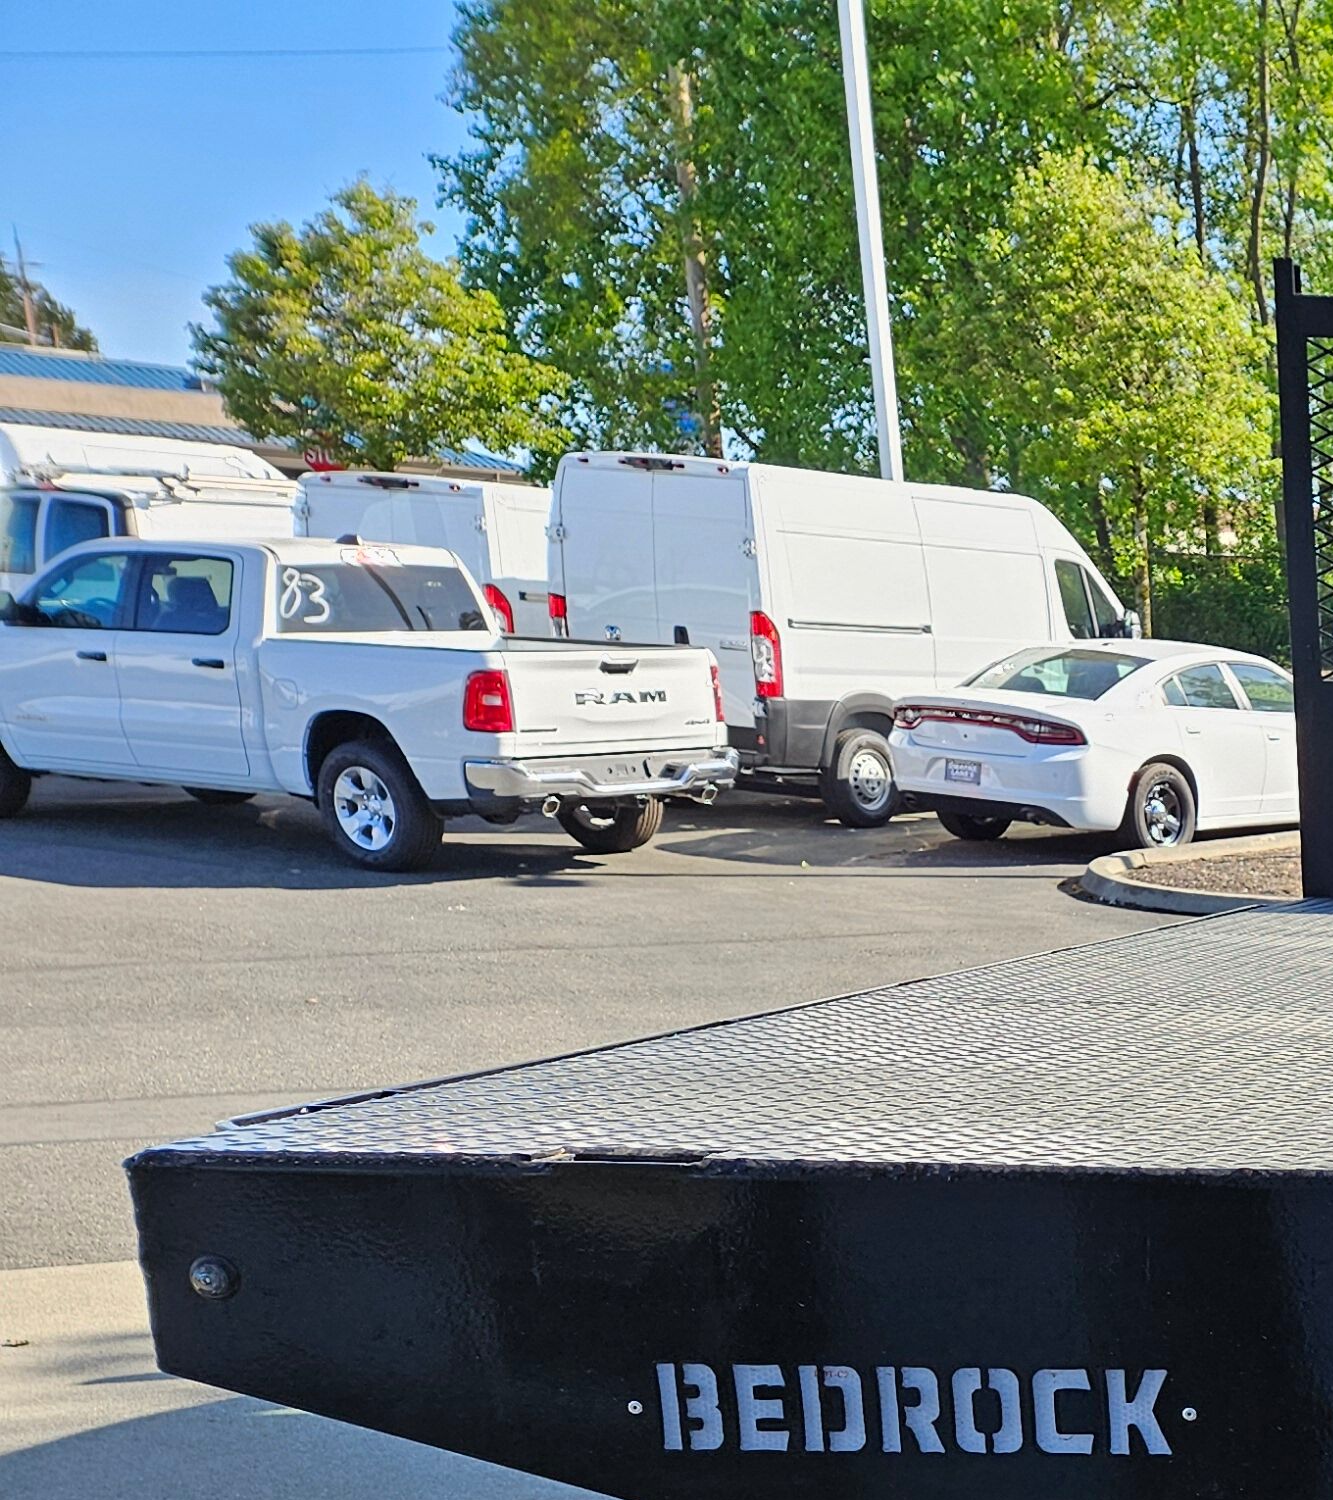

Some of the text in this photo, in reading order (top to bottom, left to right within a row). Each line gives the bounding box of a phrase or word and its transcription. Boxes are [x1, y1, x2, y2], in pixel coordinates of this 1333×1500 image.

[280, 567, 330, 623] 83
[575, 689, 667, 705] RAM
[656, 1363, 1173, 1455] BEDROCK
